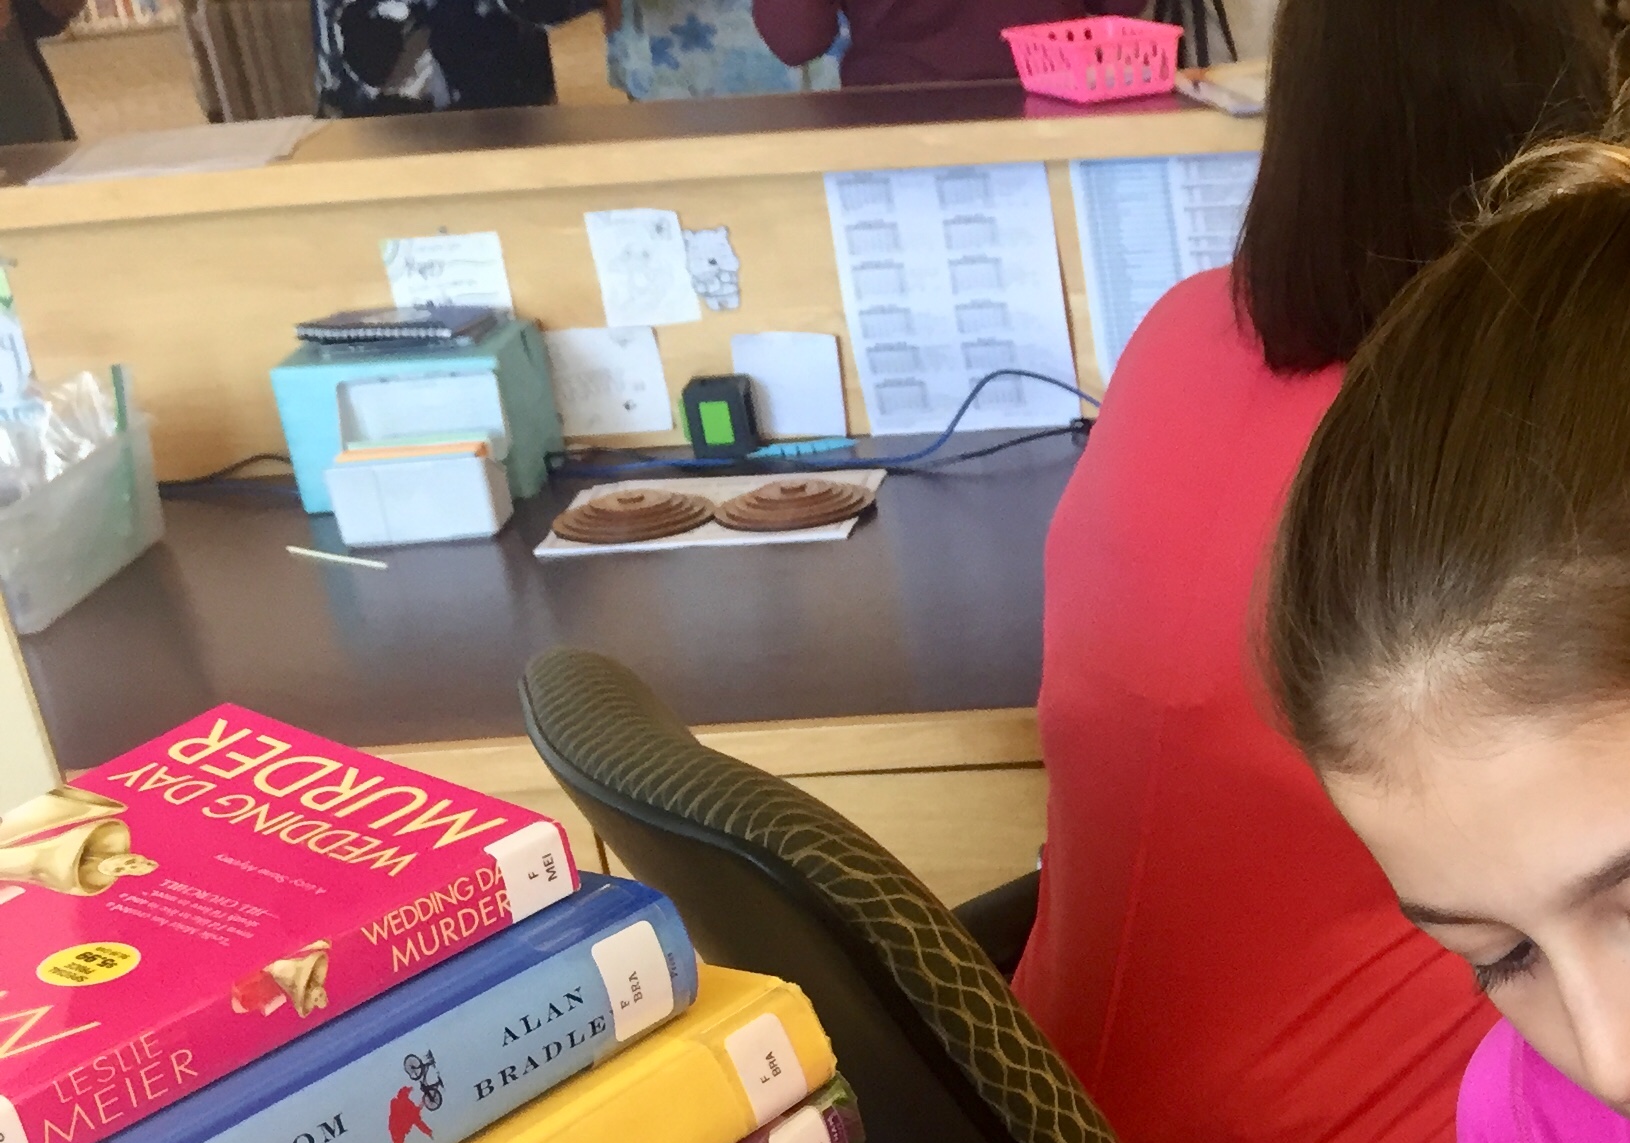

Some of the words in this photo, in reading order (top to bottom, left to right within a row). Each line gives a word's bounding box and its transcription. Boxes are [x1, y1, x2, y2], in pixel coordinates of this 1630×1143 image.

[107, 762, 216, 807] DAY
[167, 717, 508, 850] MURDER
[201, 789, 418, 876] WEDDING
[527, 871, 539, 880] F
[541, 853, 558, 882] MEI
[361, 877, 475, 945] WEDDING
[392, 890, 512, 972] MURDER
[620, 1000, 630, 1009] F
[628, 971, 643, 1003] BRA
[502, 986, 584, 1047] ALAN
[52, 1031, 163, 1104] LESLIE
[474, 1010, 614, 1101] BRADLE
[760, 1075, 771, 1085] F
[765, 1050, 782, 1078] BRA
